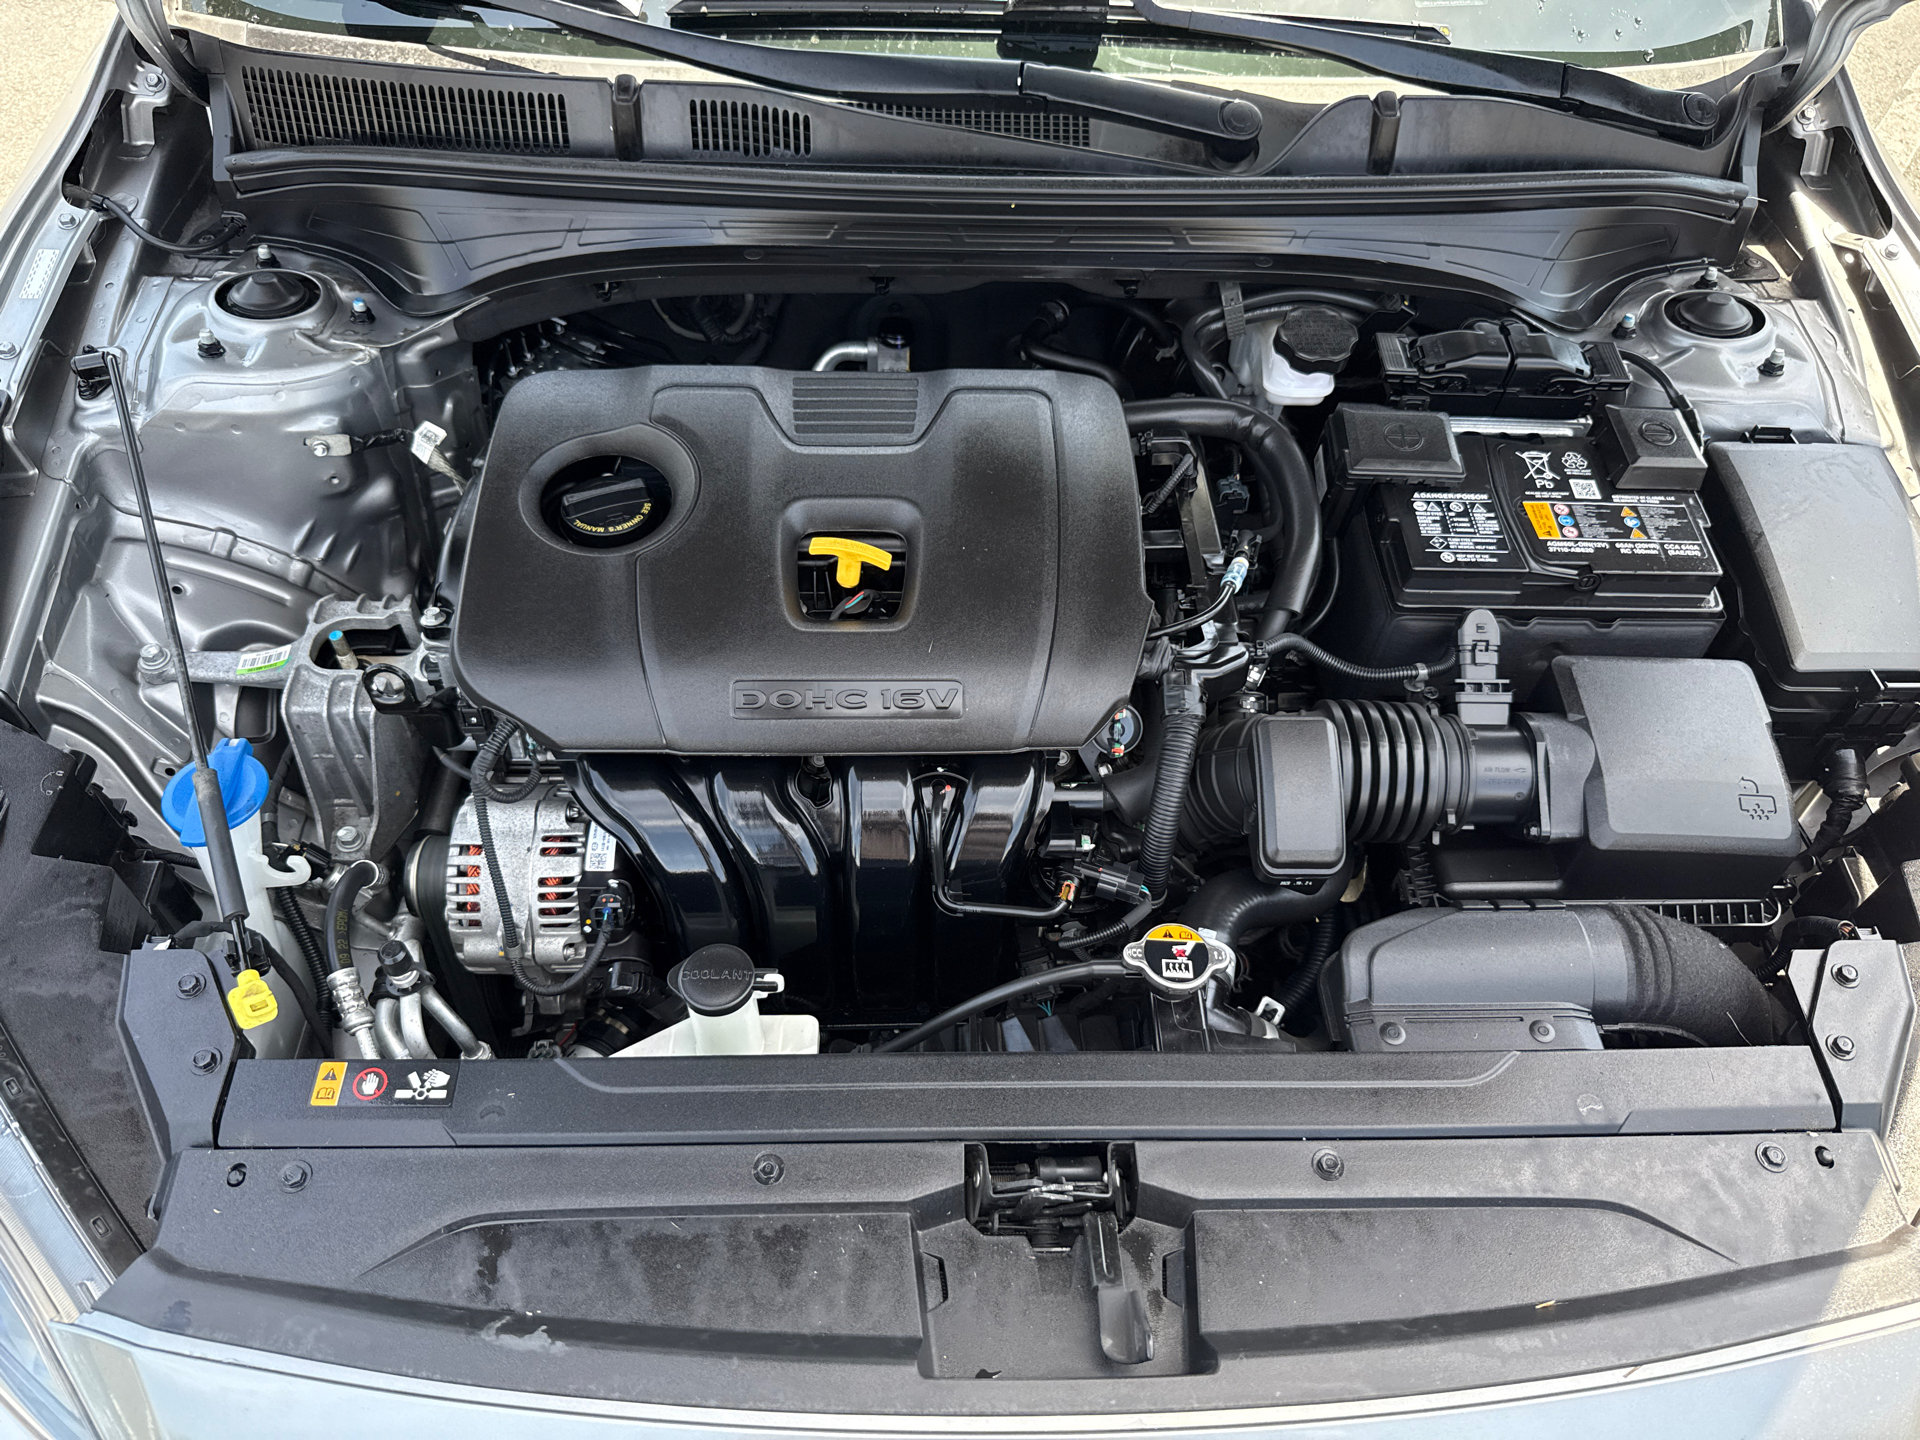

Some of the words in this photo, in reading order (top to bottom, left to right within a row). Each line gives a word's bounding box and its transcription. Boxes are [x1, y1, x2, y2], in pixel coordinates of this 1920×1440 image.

[1535, 479, 1554, 489] Pb
[641, 502, 651, 515] SEE
[573, 519, 605, 533] MANUAL
[608, 514, 644, 533] OWNER'S
[735, 689, 868, 710] DOHC
[881, 688, 959, 710] 16V
[1126, 948, 1143, 958] HCC
[681, 968, 753, 981] COOLANT
